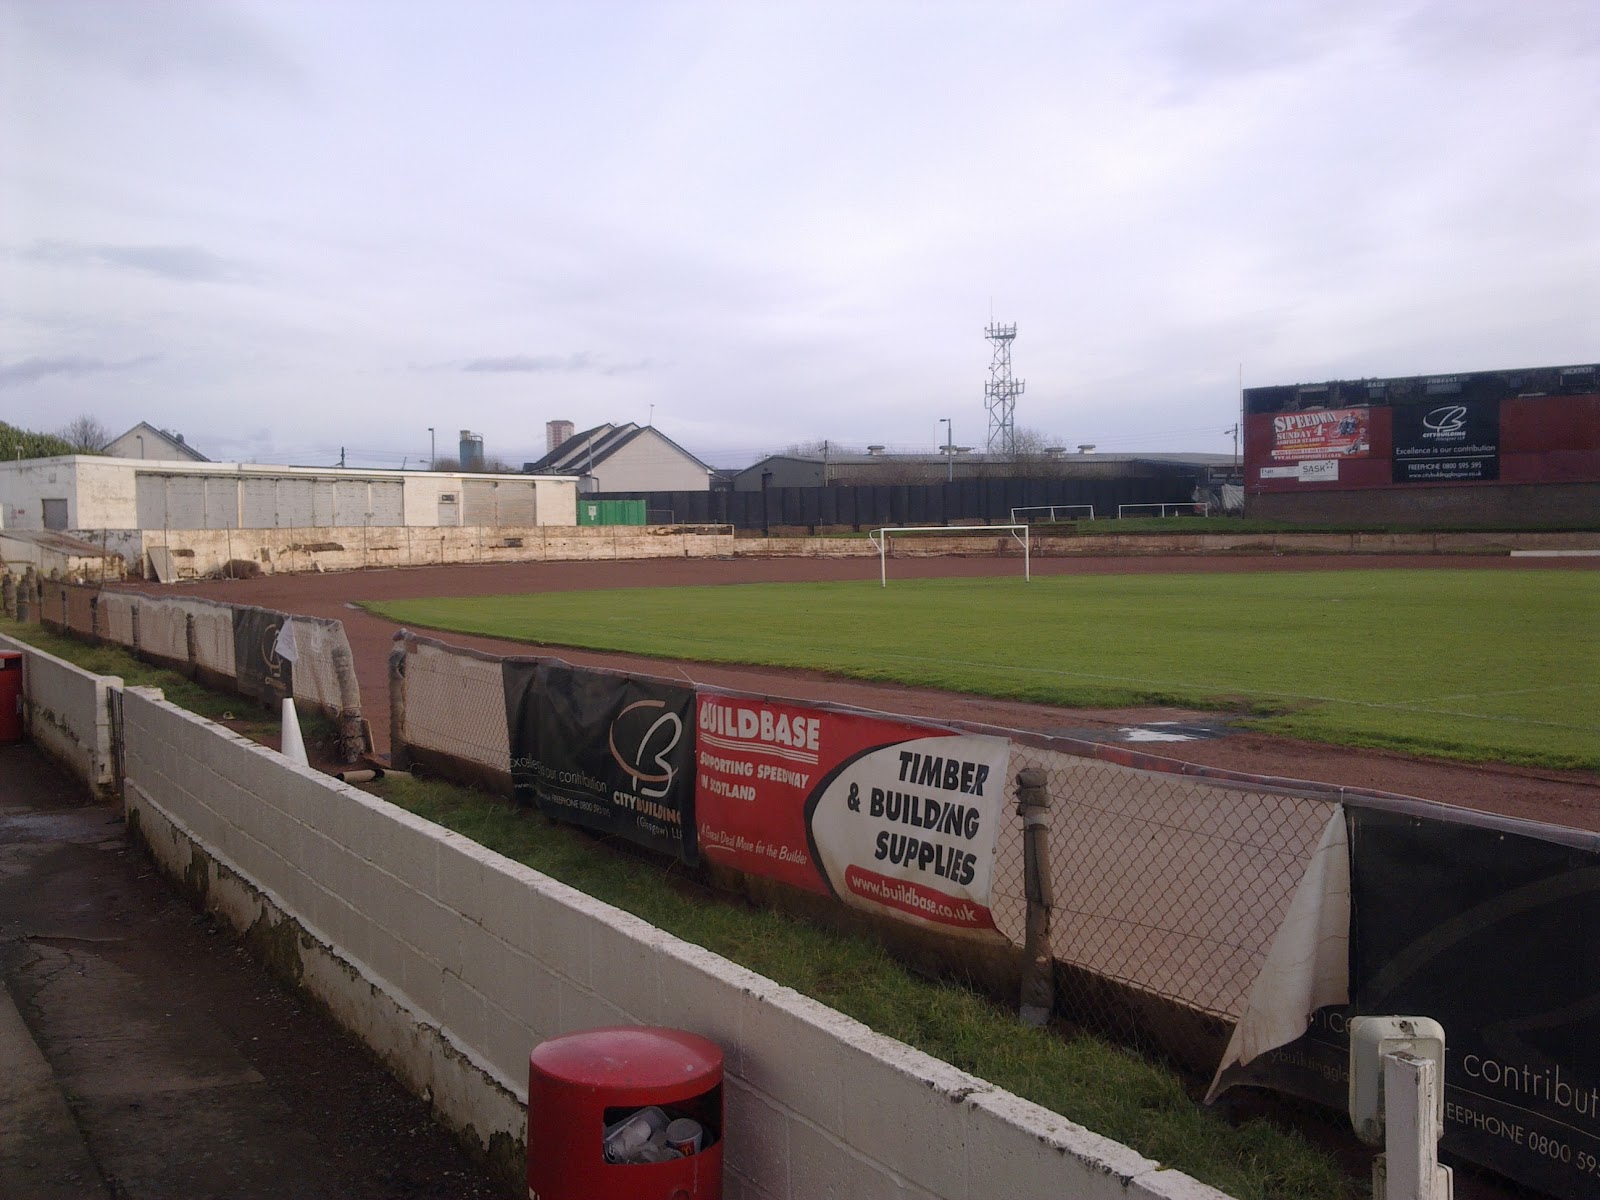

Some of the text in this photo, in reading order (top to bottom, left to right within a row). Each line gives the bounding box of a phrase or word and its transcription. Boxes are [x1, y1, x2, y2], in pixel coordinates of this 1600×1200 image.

[1277, 430, 1310, 440] SUNDAY
[1396, 447, 1431, 455] Excellence
[1453, 443, 1496, 453] contribution
[1302, 465, 1326, 473] SASK
[700, 701, 820, 751] BUILDBASE
[757, 764, 810, 789] SPEEDWAY
[899, 751, 990, 797] TIMBER
[847, 782, 980, 840] & BUILDING
[720, 831, 735, 847] Deal
[735, 836, 754, 852] More
[756, 840, 765, 855] for
[766, 844, 777, 859] the
[779, 846, 808, 865] Builder
[874, 831, 977, 885] SUPPLIES
[852, 875, 977, 922] www.buildbase.co.uk
[1445, 1102, 1525, 1145] EEPHONE
[1528, 1131, 1571, 1163] 0800
